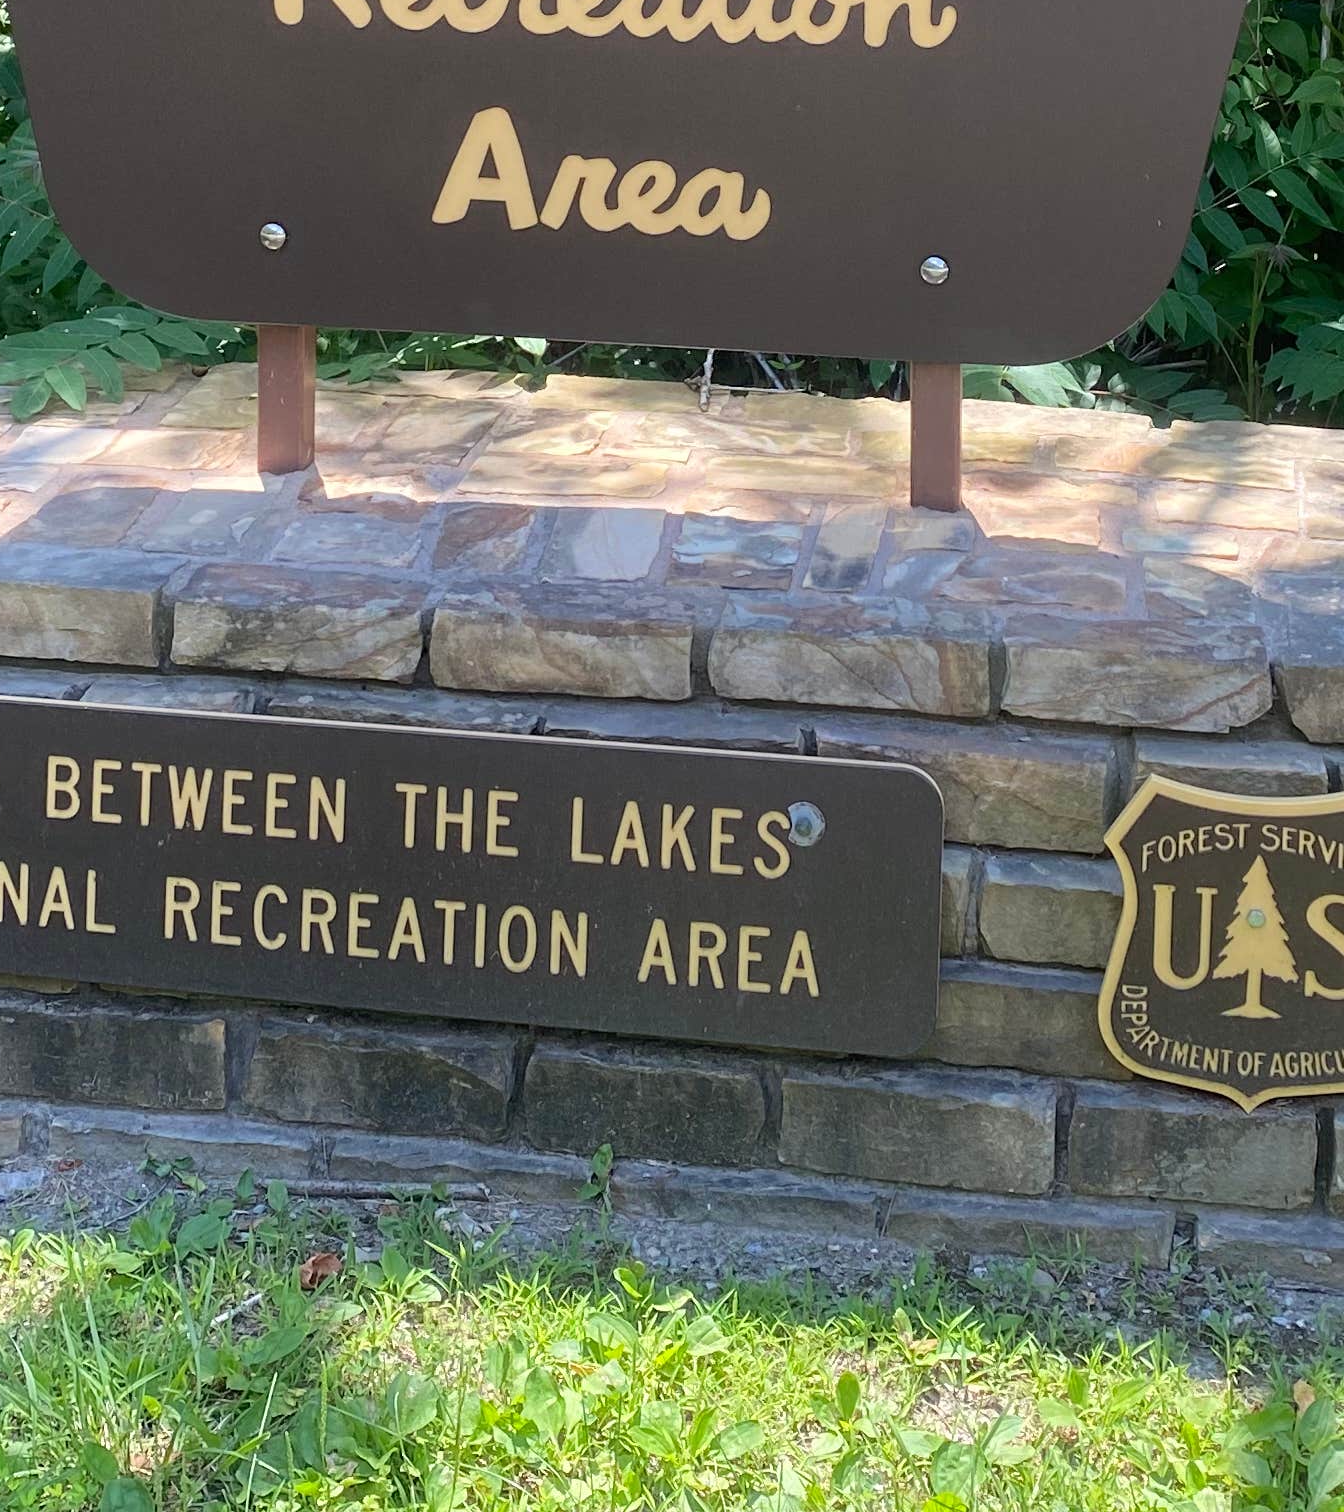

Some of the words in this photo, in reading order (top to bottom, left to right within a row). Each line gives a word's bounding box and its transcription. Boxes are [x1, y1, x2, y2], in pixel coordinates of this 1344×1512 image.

[432, 106, 772, 242] Area
[46, 755, 347, 844] BETWEEN
[395, 783, 519, 857] THE
[570, 796, 791, 879] LAKES
[1141, 823, 1251, 873] FOREST
[163, 877, 590, 978] RECREATION
[637, 918, 820, 999] AREA
[1153, 884, 1218, 990] U
[1120, 983, 1233, 1074] DEPARTMENT
[1237, 1051, 1267, 1077] OF
